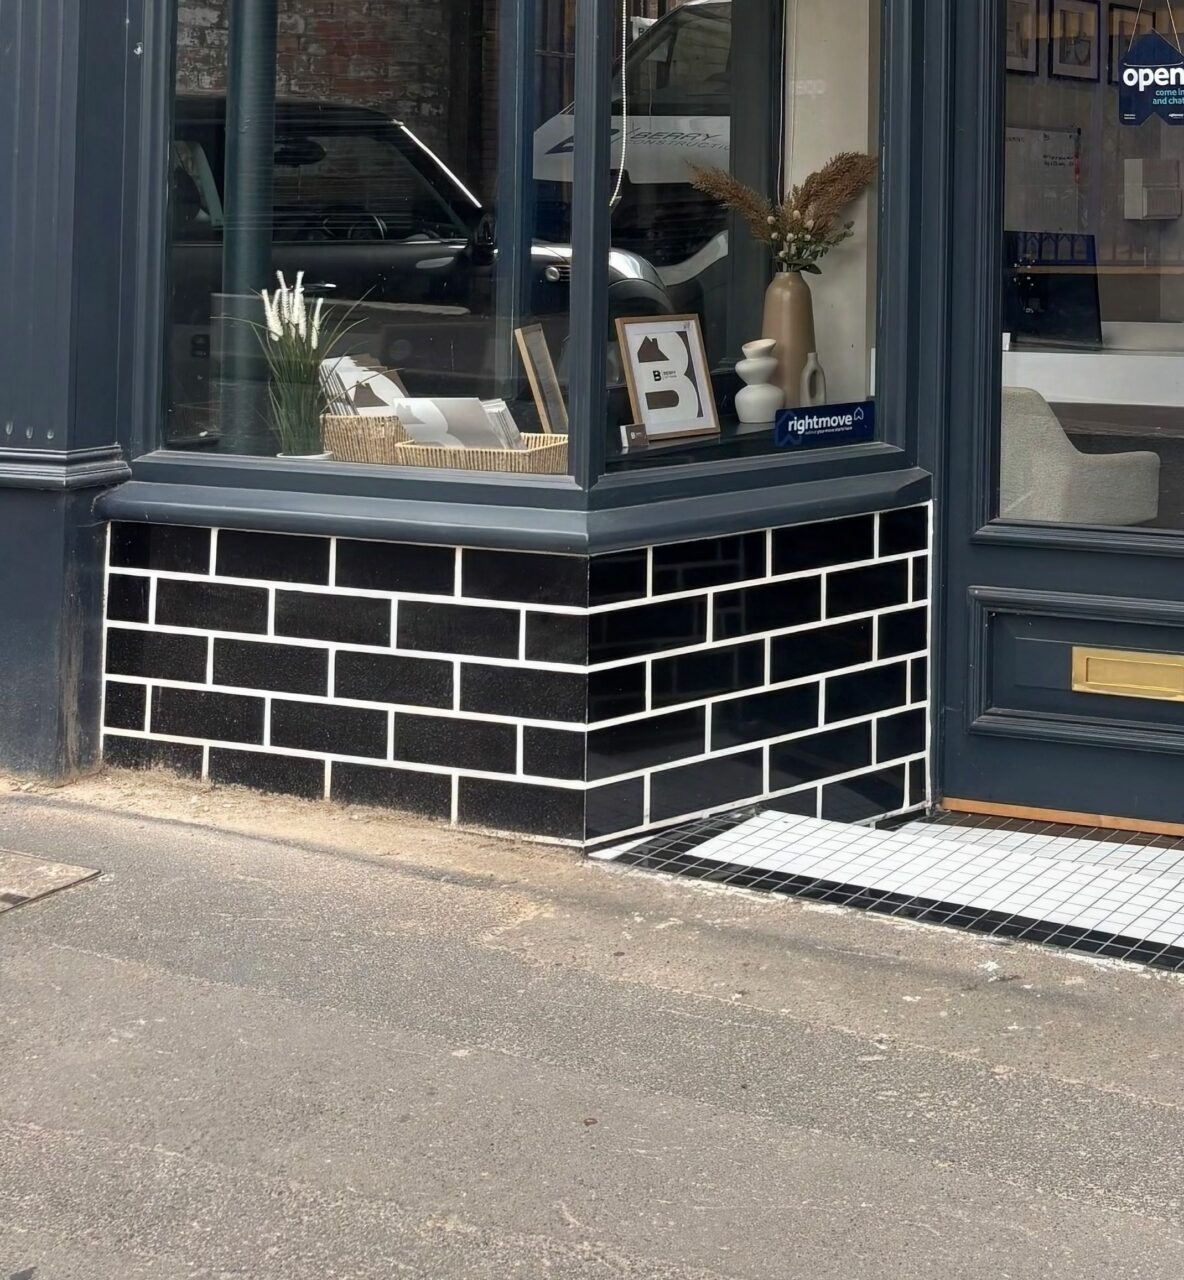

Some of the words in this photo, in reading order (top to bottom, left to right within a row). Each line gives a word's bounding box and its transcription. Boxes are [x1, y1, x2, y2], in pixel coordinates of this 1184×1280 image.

[1152, 97, 1168, 105] and
[630, 131, 722, 141] BERRY
[788, 414, 852, 435] rightmove
